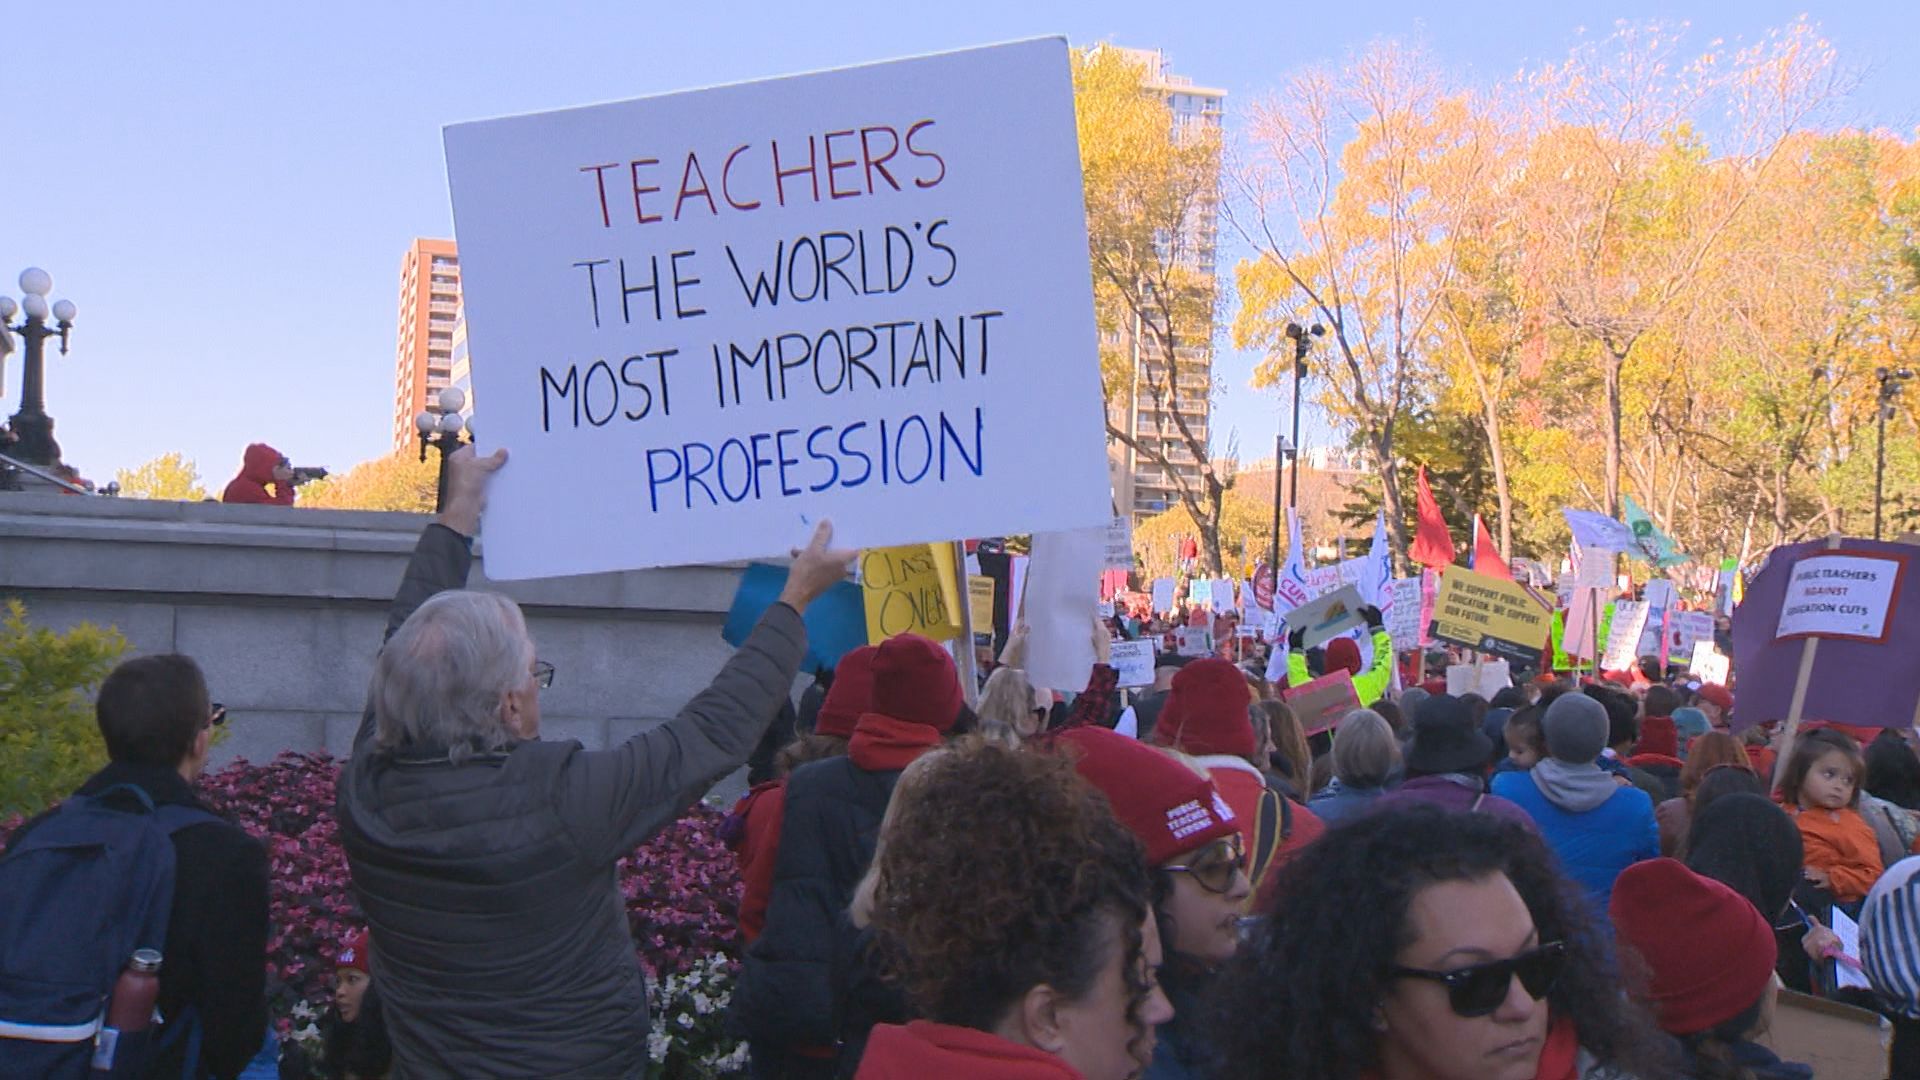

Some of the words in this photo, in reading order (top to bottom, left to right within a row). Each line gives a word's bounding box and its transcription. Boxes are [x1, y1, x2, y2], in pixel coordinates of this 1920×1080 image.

[580, 119, 946, 228] TEACHERS
[573, 250, 707, 328] THE
[725, 219, 957, 308] WORLD'S
[541, 349, 679, 432] MOST
[713, 311, 1003, 408] IMPORTANT
[646, 407, 984, 513] PROFESSION
[1822, 569, 1878, 582] TEACHERS
[1279, 578, 1309, 603] CUP
[1466, 584, 1500, 600] SUPPORT
[1804, 586, 1849, 597] AGAINST
[1507, 609, 1540, 625] SUPPORT
[1839, 604, 1869, 617] CUTS
